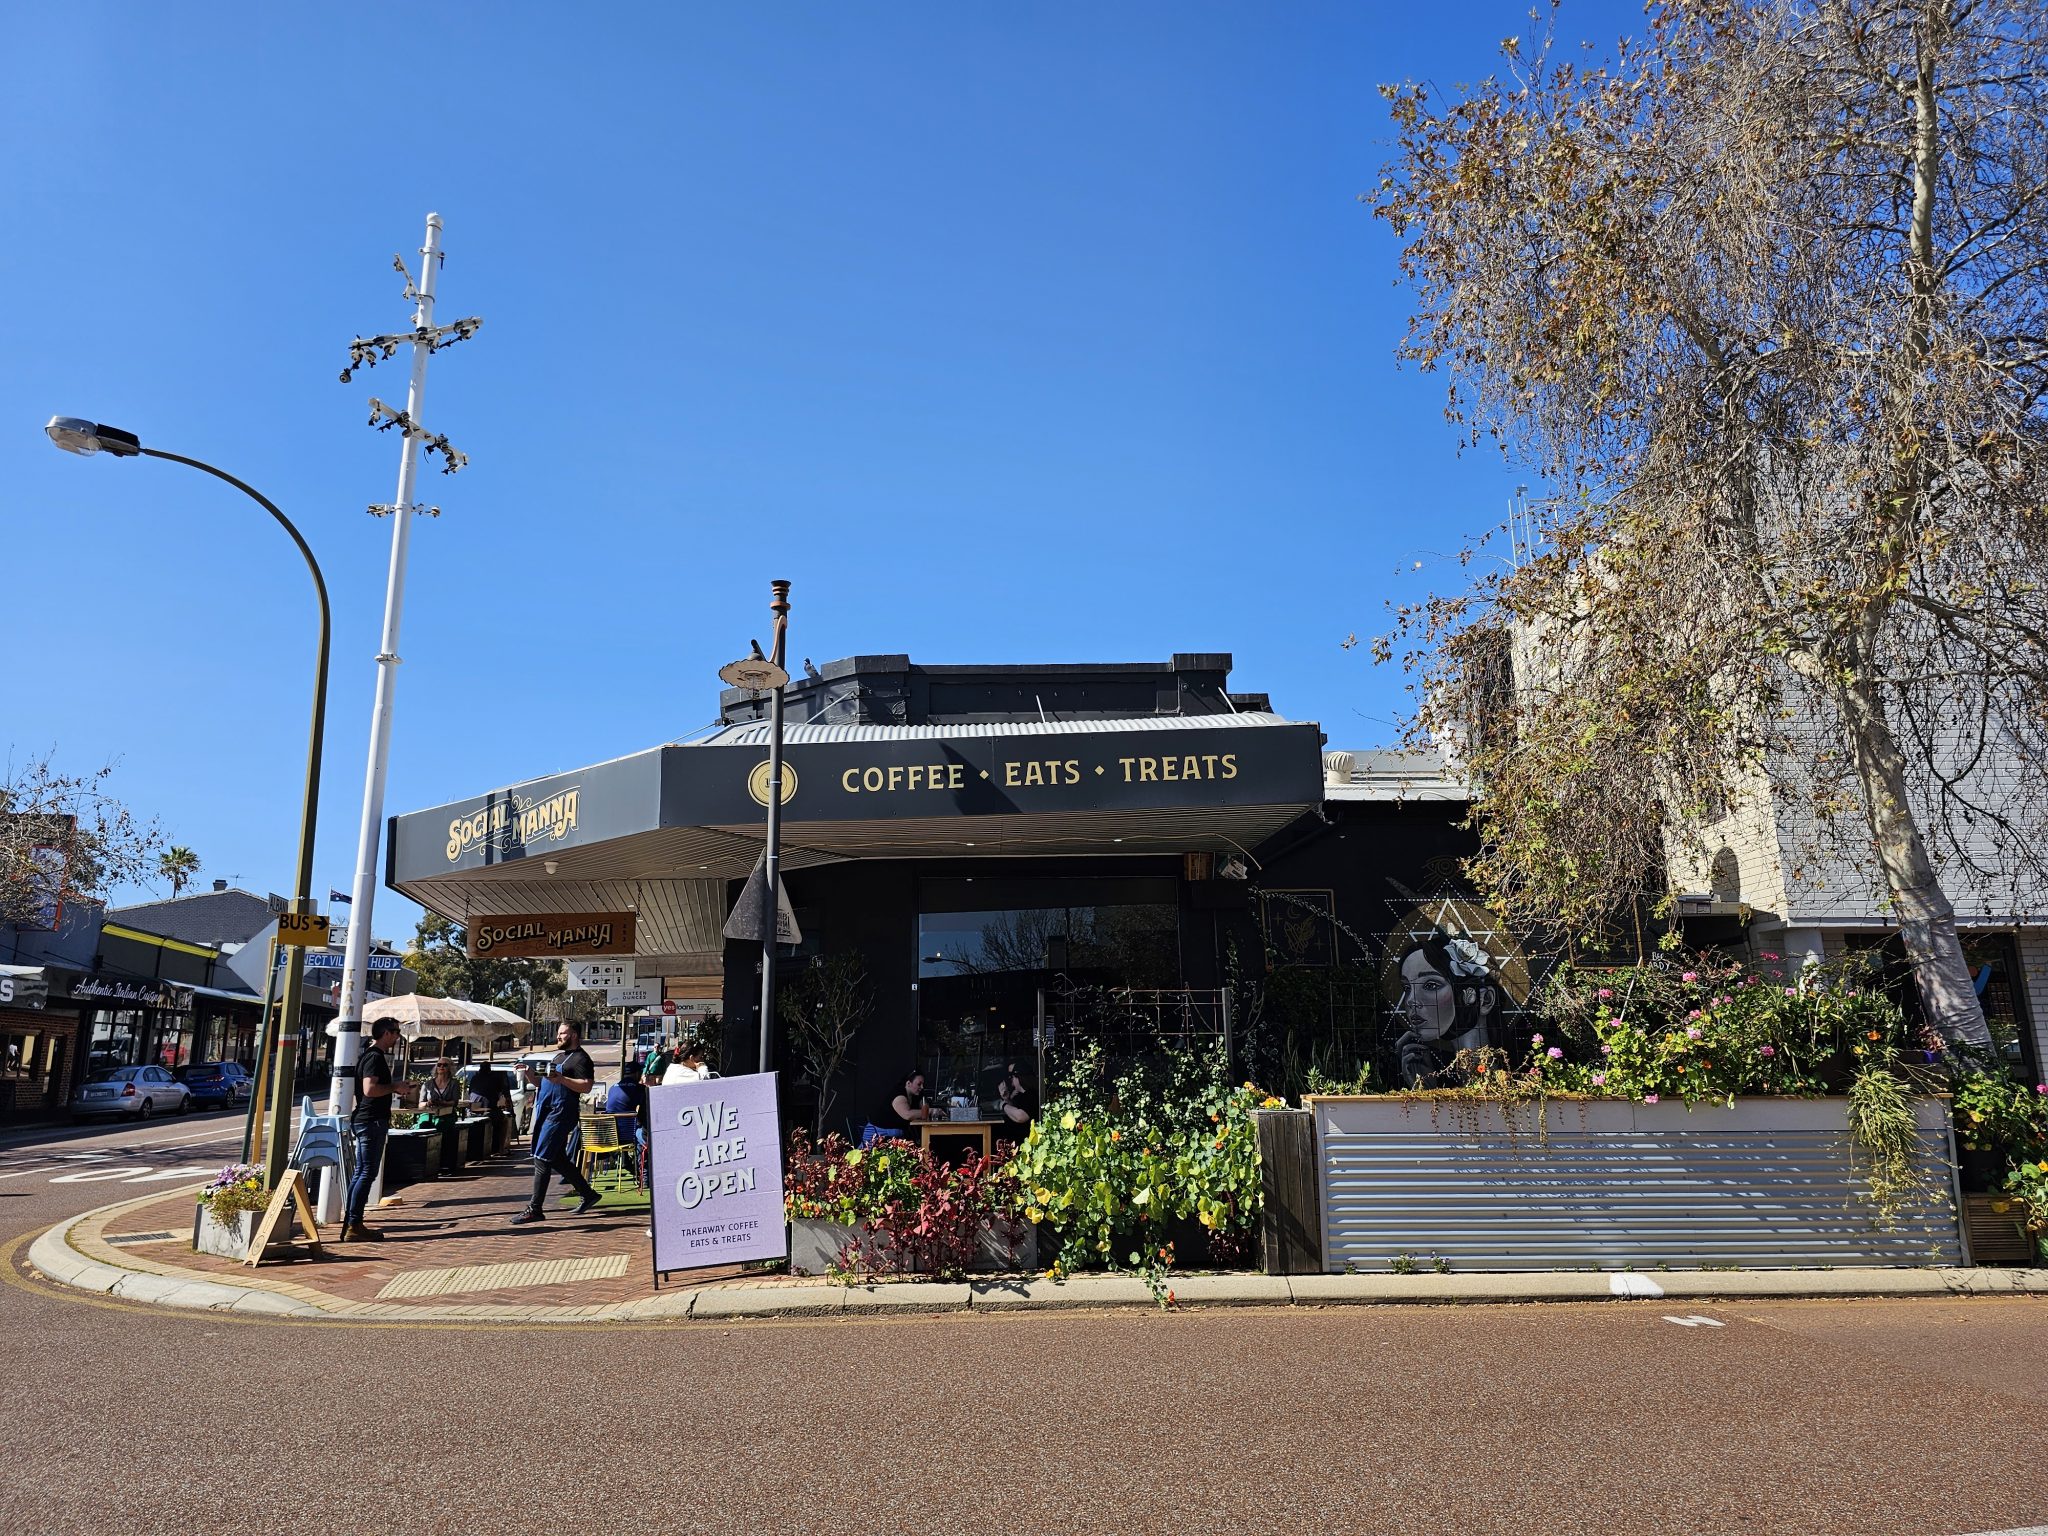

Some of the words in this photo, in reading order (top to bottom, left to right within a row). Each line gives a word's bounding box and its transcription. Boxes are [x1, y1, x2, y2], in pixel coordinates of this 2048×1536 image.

[842, 764, 965, 793] COFFEE
[1005, 760, 1081, 787] EATS
[1119, 754, 1238, 783] TREATS
[446, 803, 512, 863] SOCIAL
[511, 790, 580, 848] MANNA
[280, 914, 310, 931] BUS
[476, 922, 545, 950] SOCIAL
[548, 923, 613, 949] MANNA
[280, 954, 327, 967] CNECT
[370, 957, 391, 969] HUB
[592, 966, 623, 974] Ben
[74, 977, 113, 996] Authentic
[113, 982, 138, 998] Italian
[580, 976, 621, 985] tori
[677, 1101, 740, 1140] WE
[693, 1136, 747, 1169] ARE
[676, 1167, 756, 1209] OPEN
[681, 1224, 726, 1237] TAKEAWAY
[728, 1220, 759, 1231] COFFEE
[690, 1237, 710, 1248] EATS
[712, 1236, 719, 1245] &
[722, 1233, 752, 1244] TREATS
